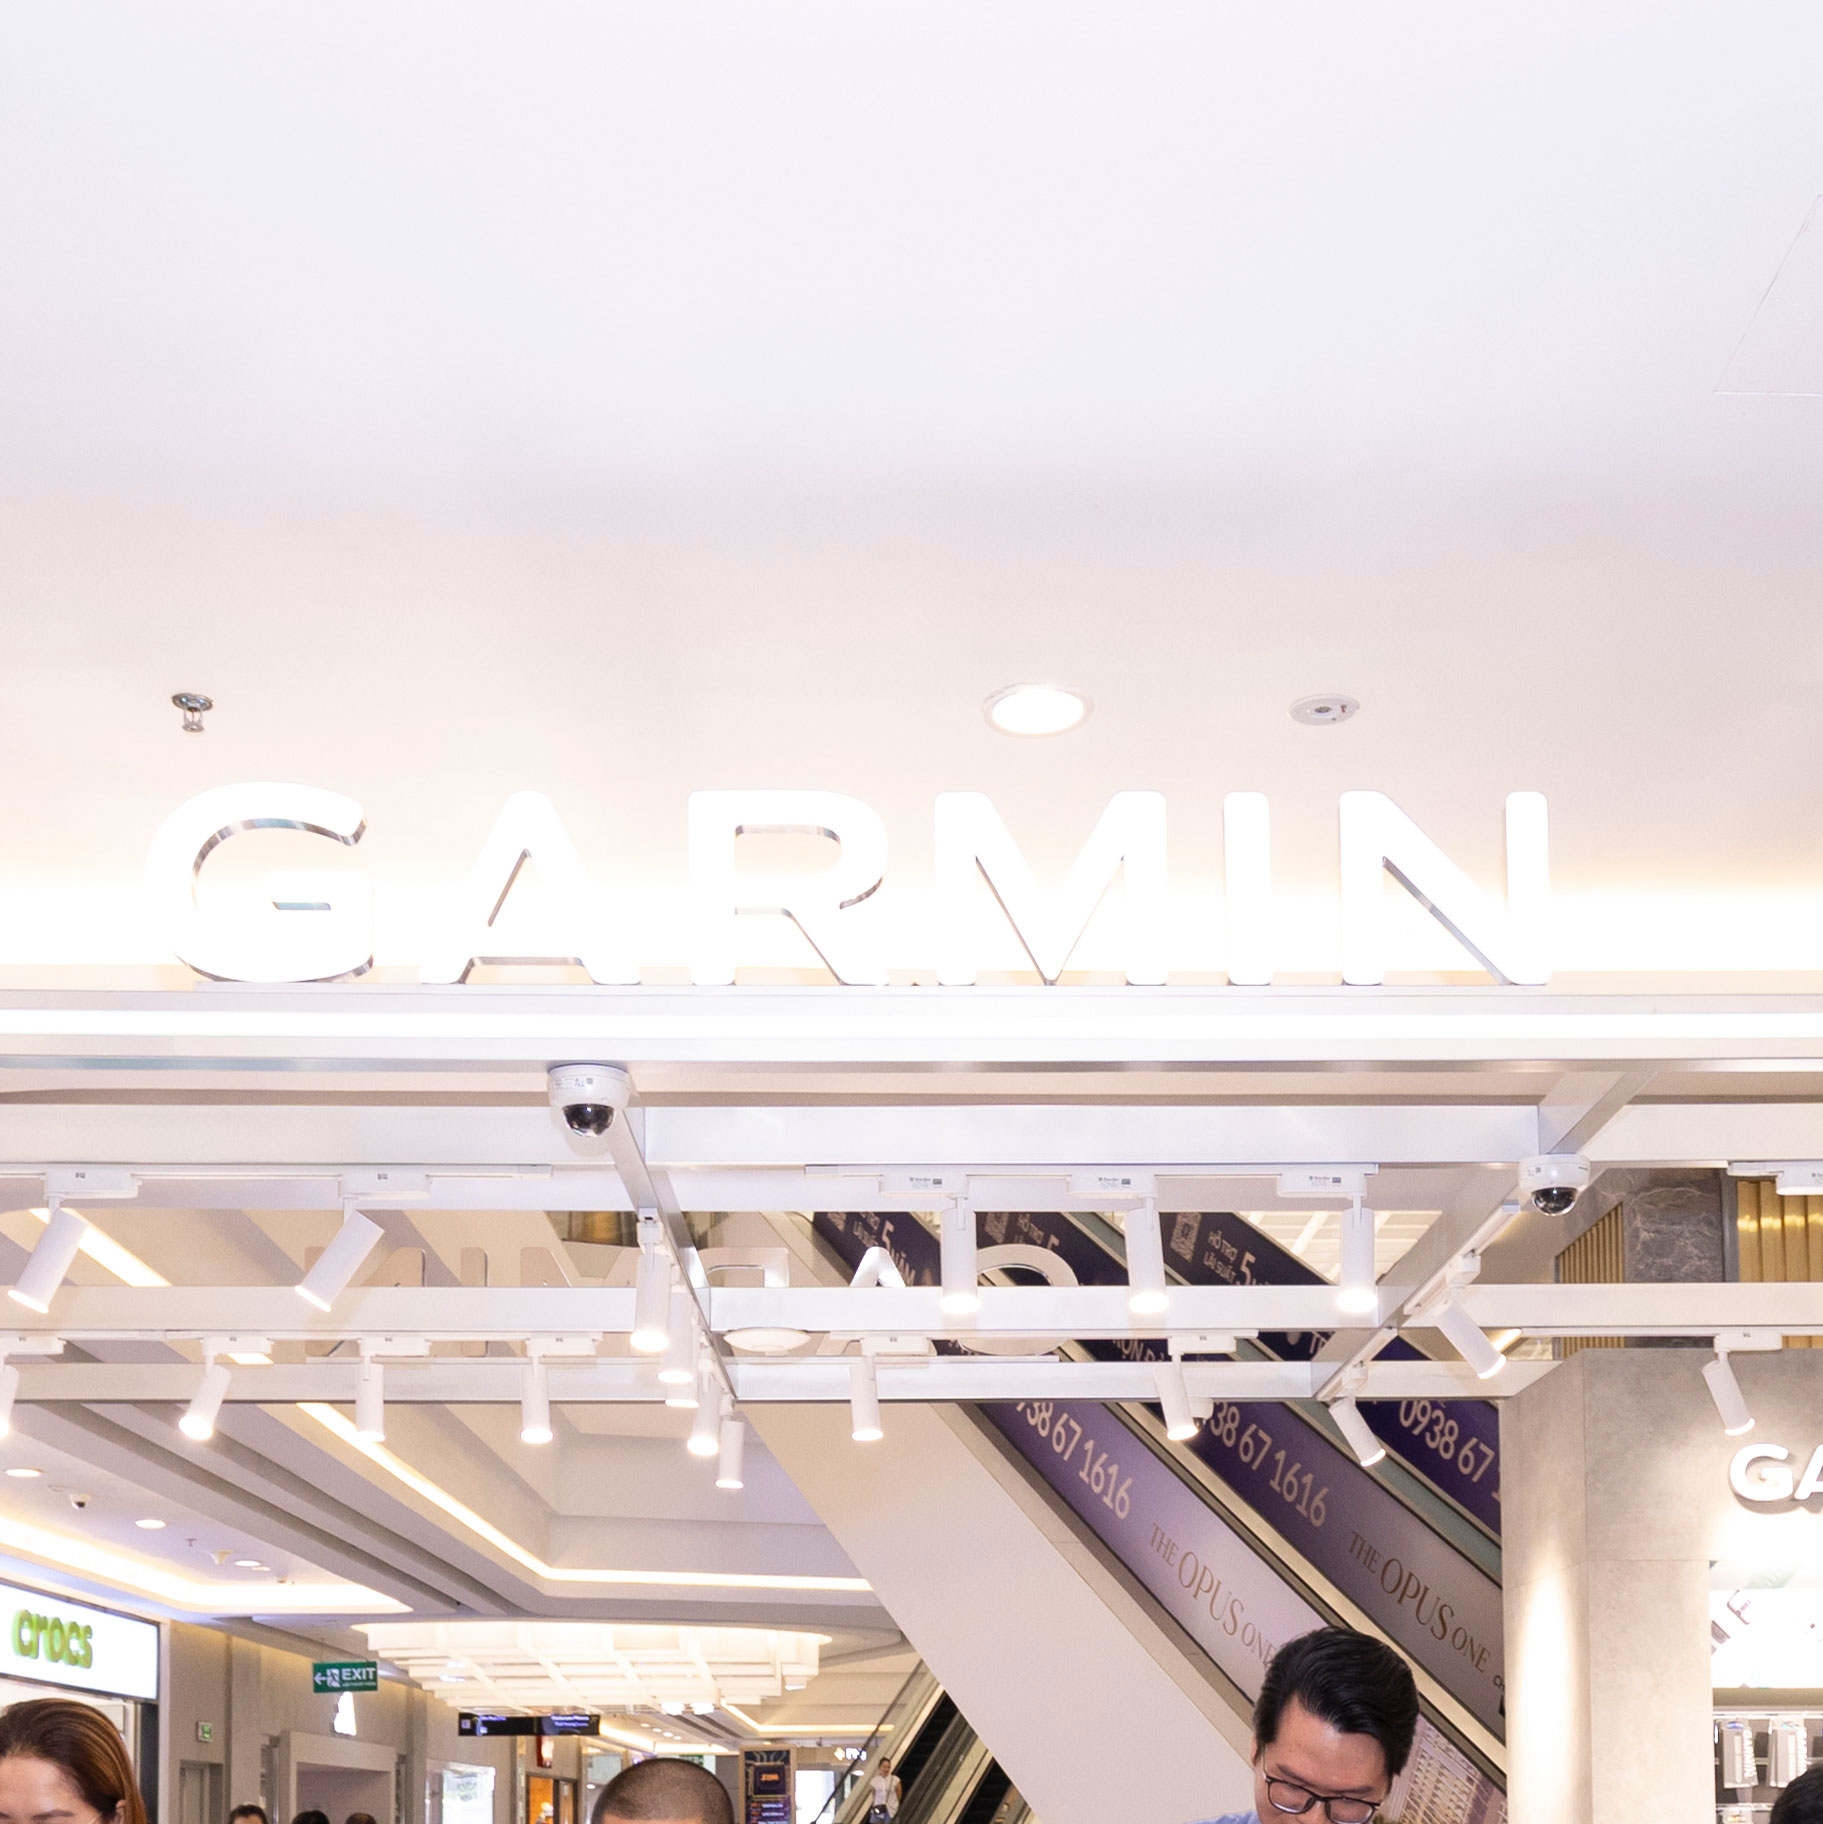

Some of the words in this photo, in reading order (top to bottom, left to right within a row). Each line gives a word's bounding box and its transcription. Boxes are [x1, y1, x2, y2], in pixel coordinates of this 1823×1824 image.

[144, 782, 1549, 988] GARMIN
[1050, 1411, 1083, 1463] 67
[1079, 1438, 1133, 1520] 1616
[1237, 1422, 1275, 1470] 67
[1270, 1448, 1330, 1528] 1616
[1397, 1400, 1461, 1461] 0938
[1457, 1434, 1497, 1481] 67
[11, 1609, 93, 1669] crocs
[1149, 1523, 1179, 1567] THE
[1177, 1551, 1245, 1637] OPUS
[1241, 1621, 1278, 1669] ONE
[1349, 1530, 1384, 1575] THE
[1380, 1557, 1455, 1641] OPUS
[1452, 1626, 1491, 1674] ONE
[341, 1667, 376, 1681] EXIT
